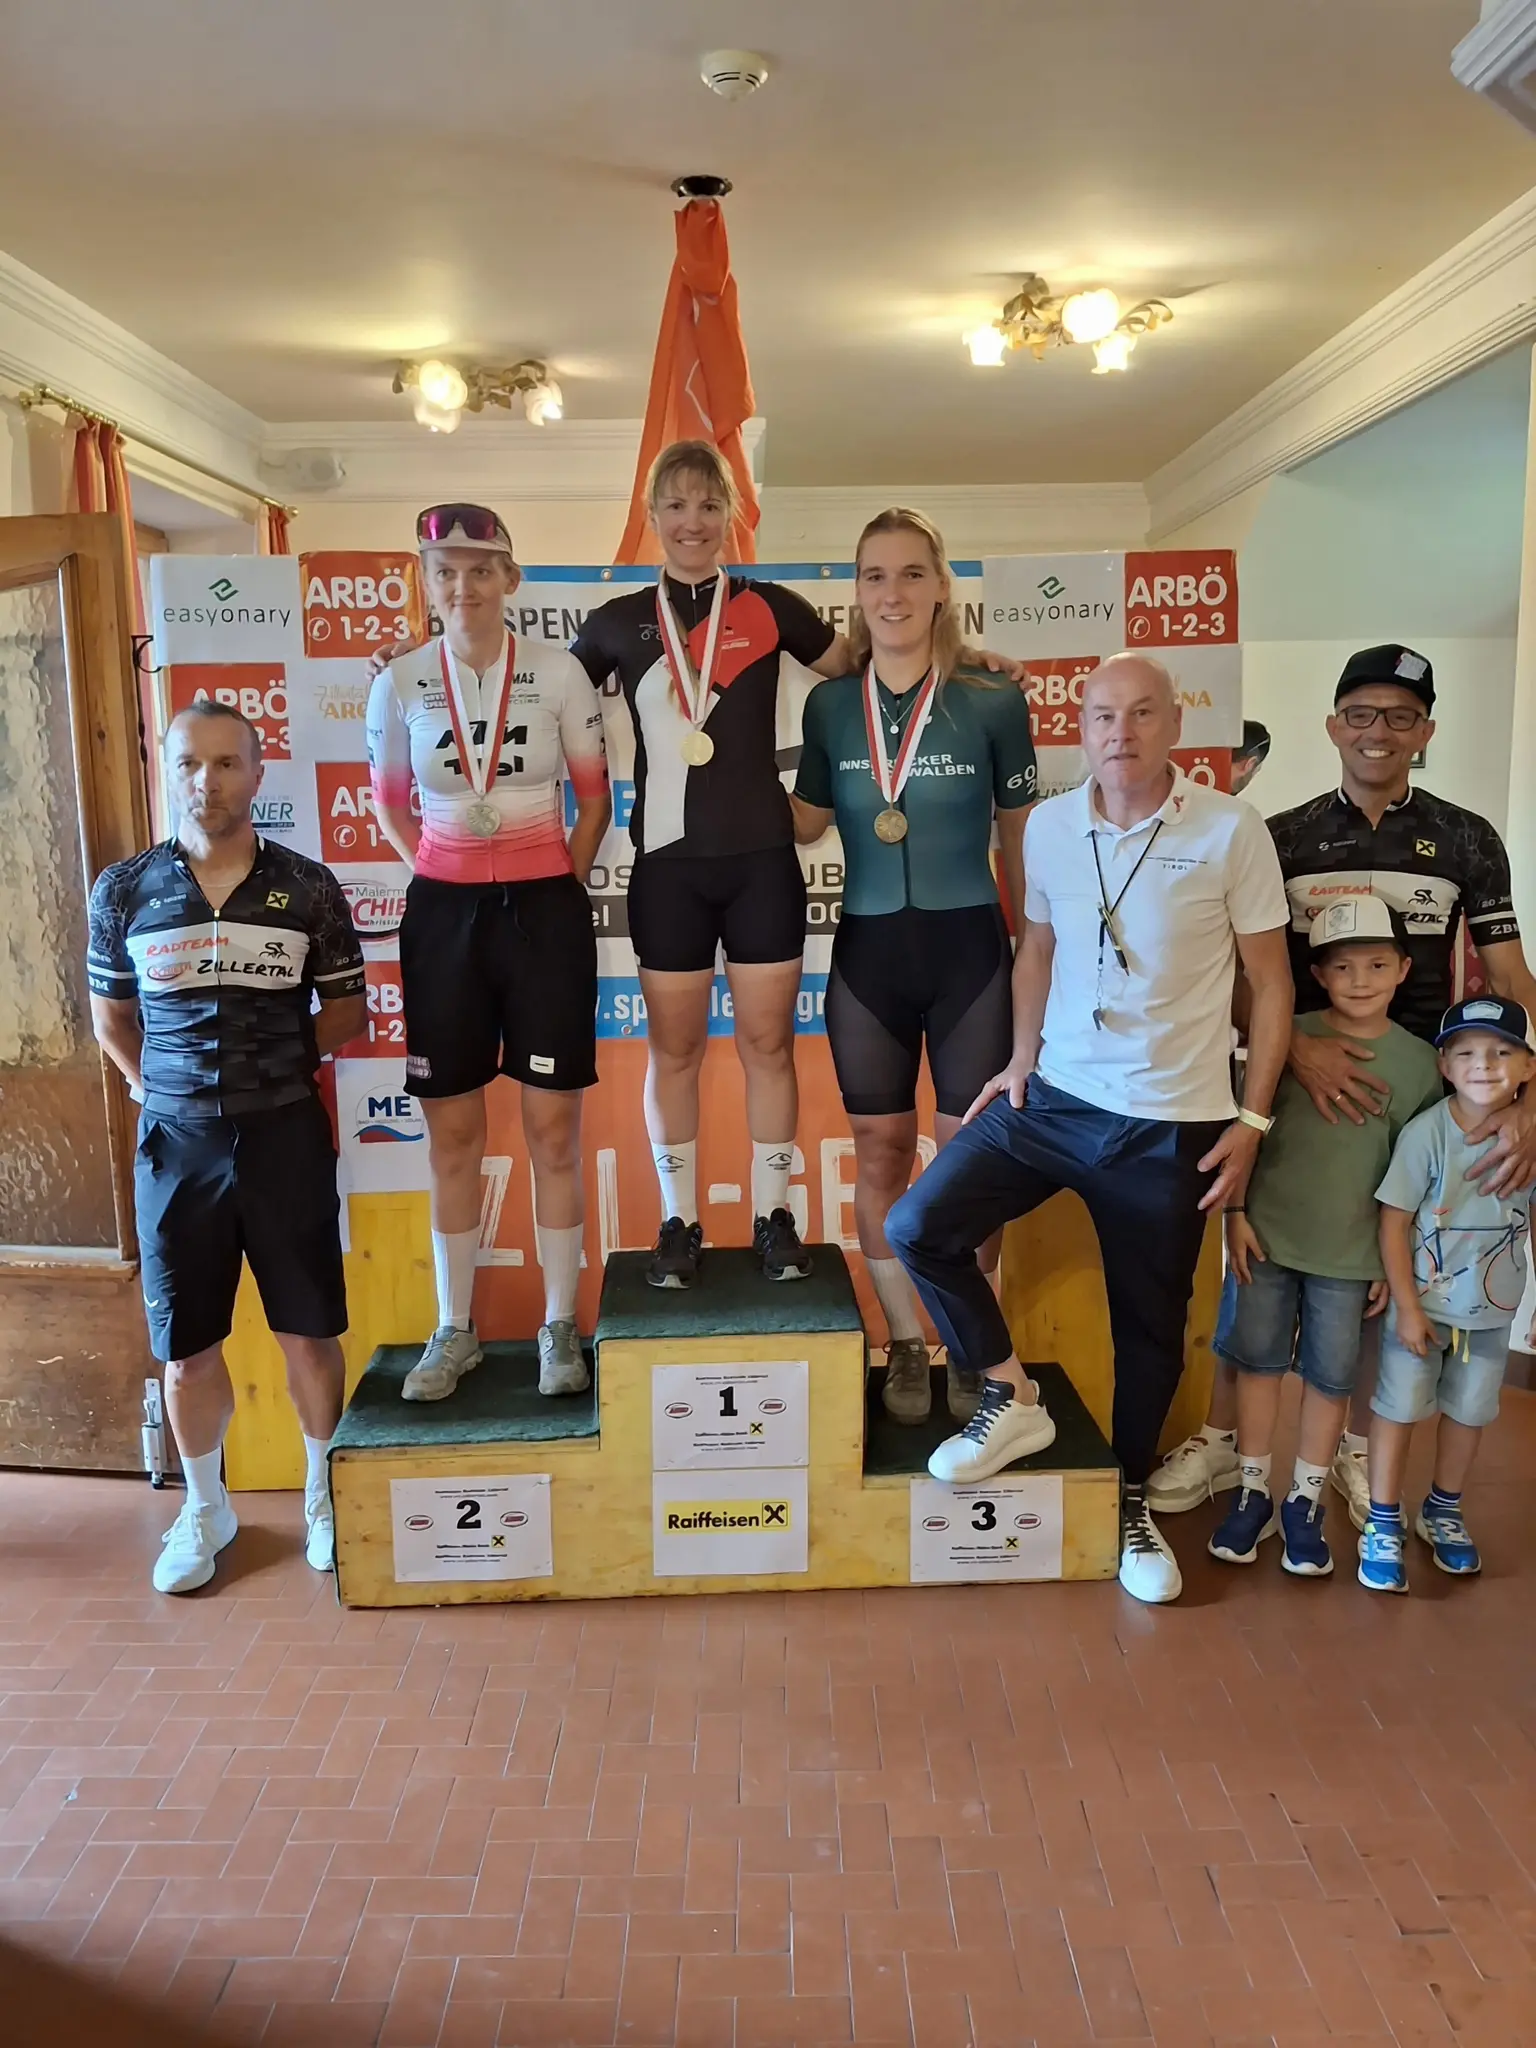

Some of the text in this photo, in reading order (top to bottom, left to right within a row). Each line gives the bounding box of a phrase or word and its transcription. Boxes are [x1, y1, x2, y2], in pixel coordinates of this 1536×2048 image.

[304, 568, 409, 609] ARBÖ
[1127, 566, 1228, 608] ARBÖ
[163, 606, 291, 627] easyonary
[993, 602, 1115, 625] easyonary
[1160, 612, 1226, 638] 1-2-3
[340, 615, 410, 641] 1-2-3
[1026, 665, 1088, 707] RBÖ
[251, 802, 293, 820] NER
[356, 887, 405, 898] Malerm
[1308, 885, 1374, 896] RADTEAM
[1399, 911, 1444, 924] ERTAL
[146, 936, 230, 957] RADTEAM
[197, 959, 294, 978] ZILLERTAL
[719, 1386, 738, 1417] 1
[456, 1500, 482, 1529] 2
[668, 1511, 760, 1529] Raiffeisen
[971, 1501, 997, 1531] 3
